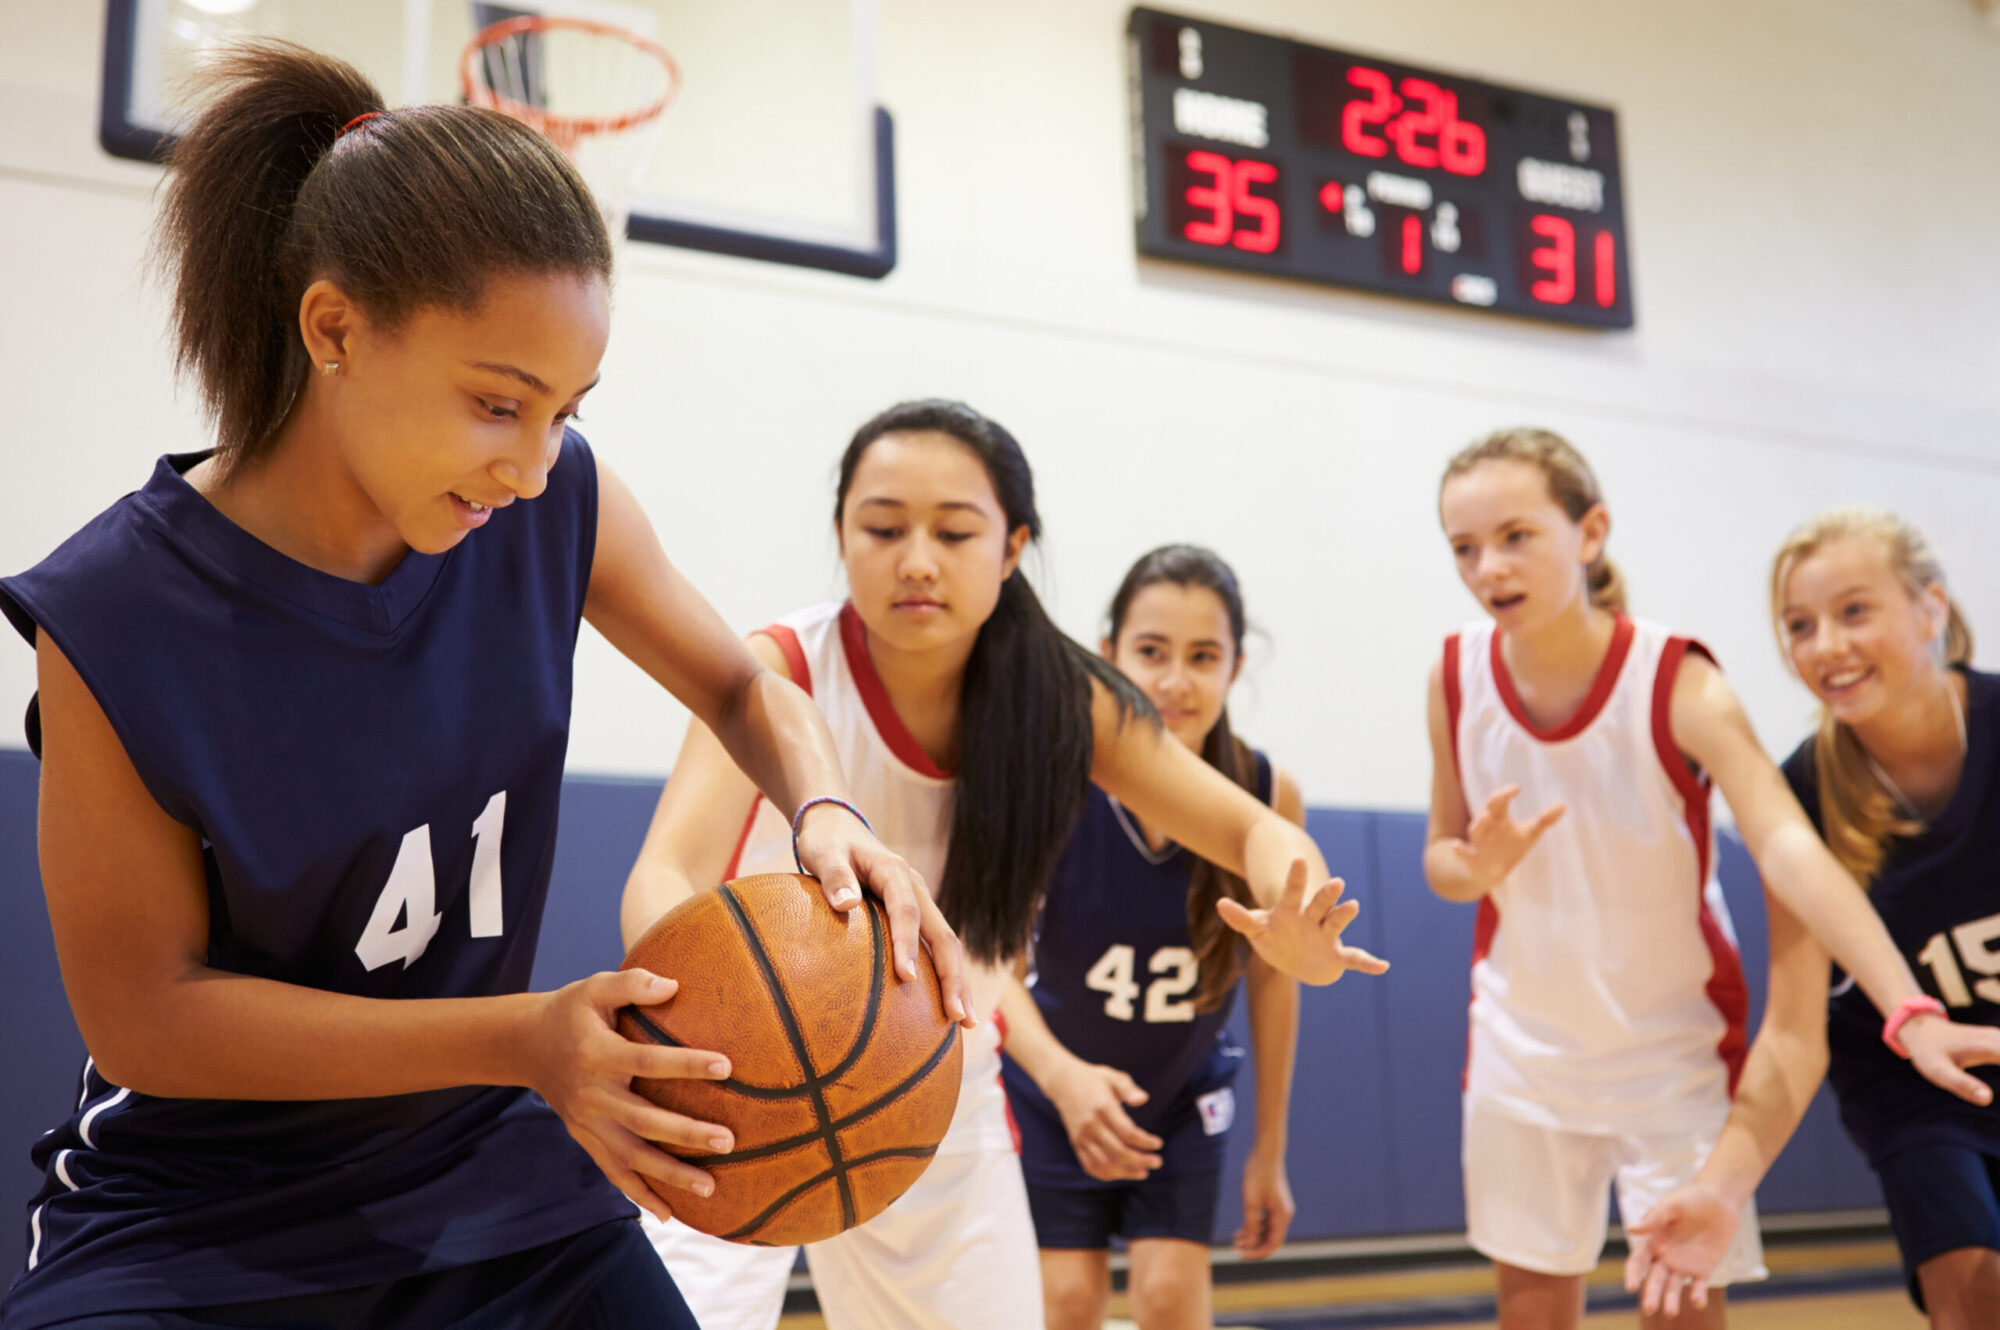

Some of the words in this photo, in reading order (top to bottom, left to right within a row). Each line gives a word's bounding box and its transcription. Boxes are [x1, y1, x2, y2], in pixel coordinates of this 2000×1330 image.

[1184, 150, 1281, 254] 35
[1402, 214, 1422, 275] 1
[1530, 213, 1616, 308] 31
[354, 789, 507, 973] 41
[1085, 943, 1200, 1023] 42
[1917, 912, 2000, 1008] 15
